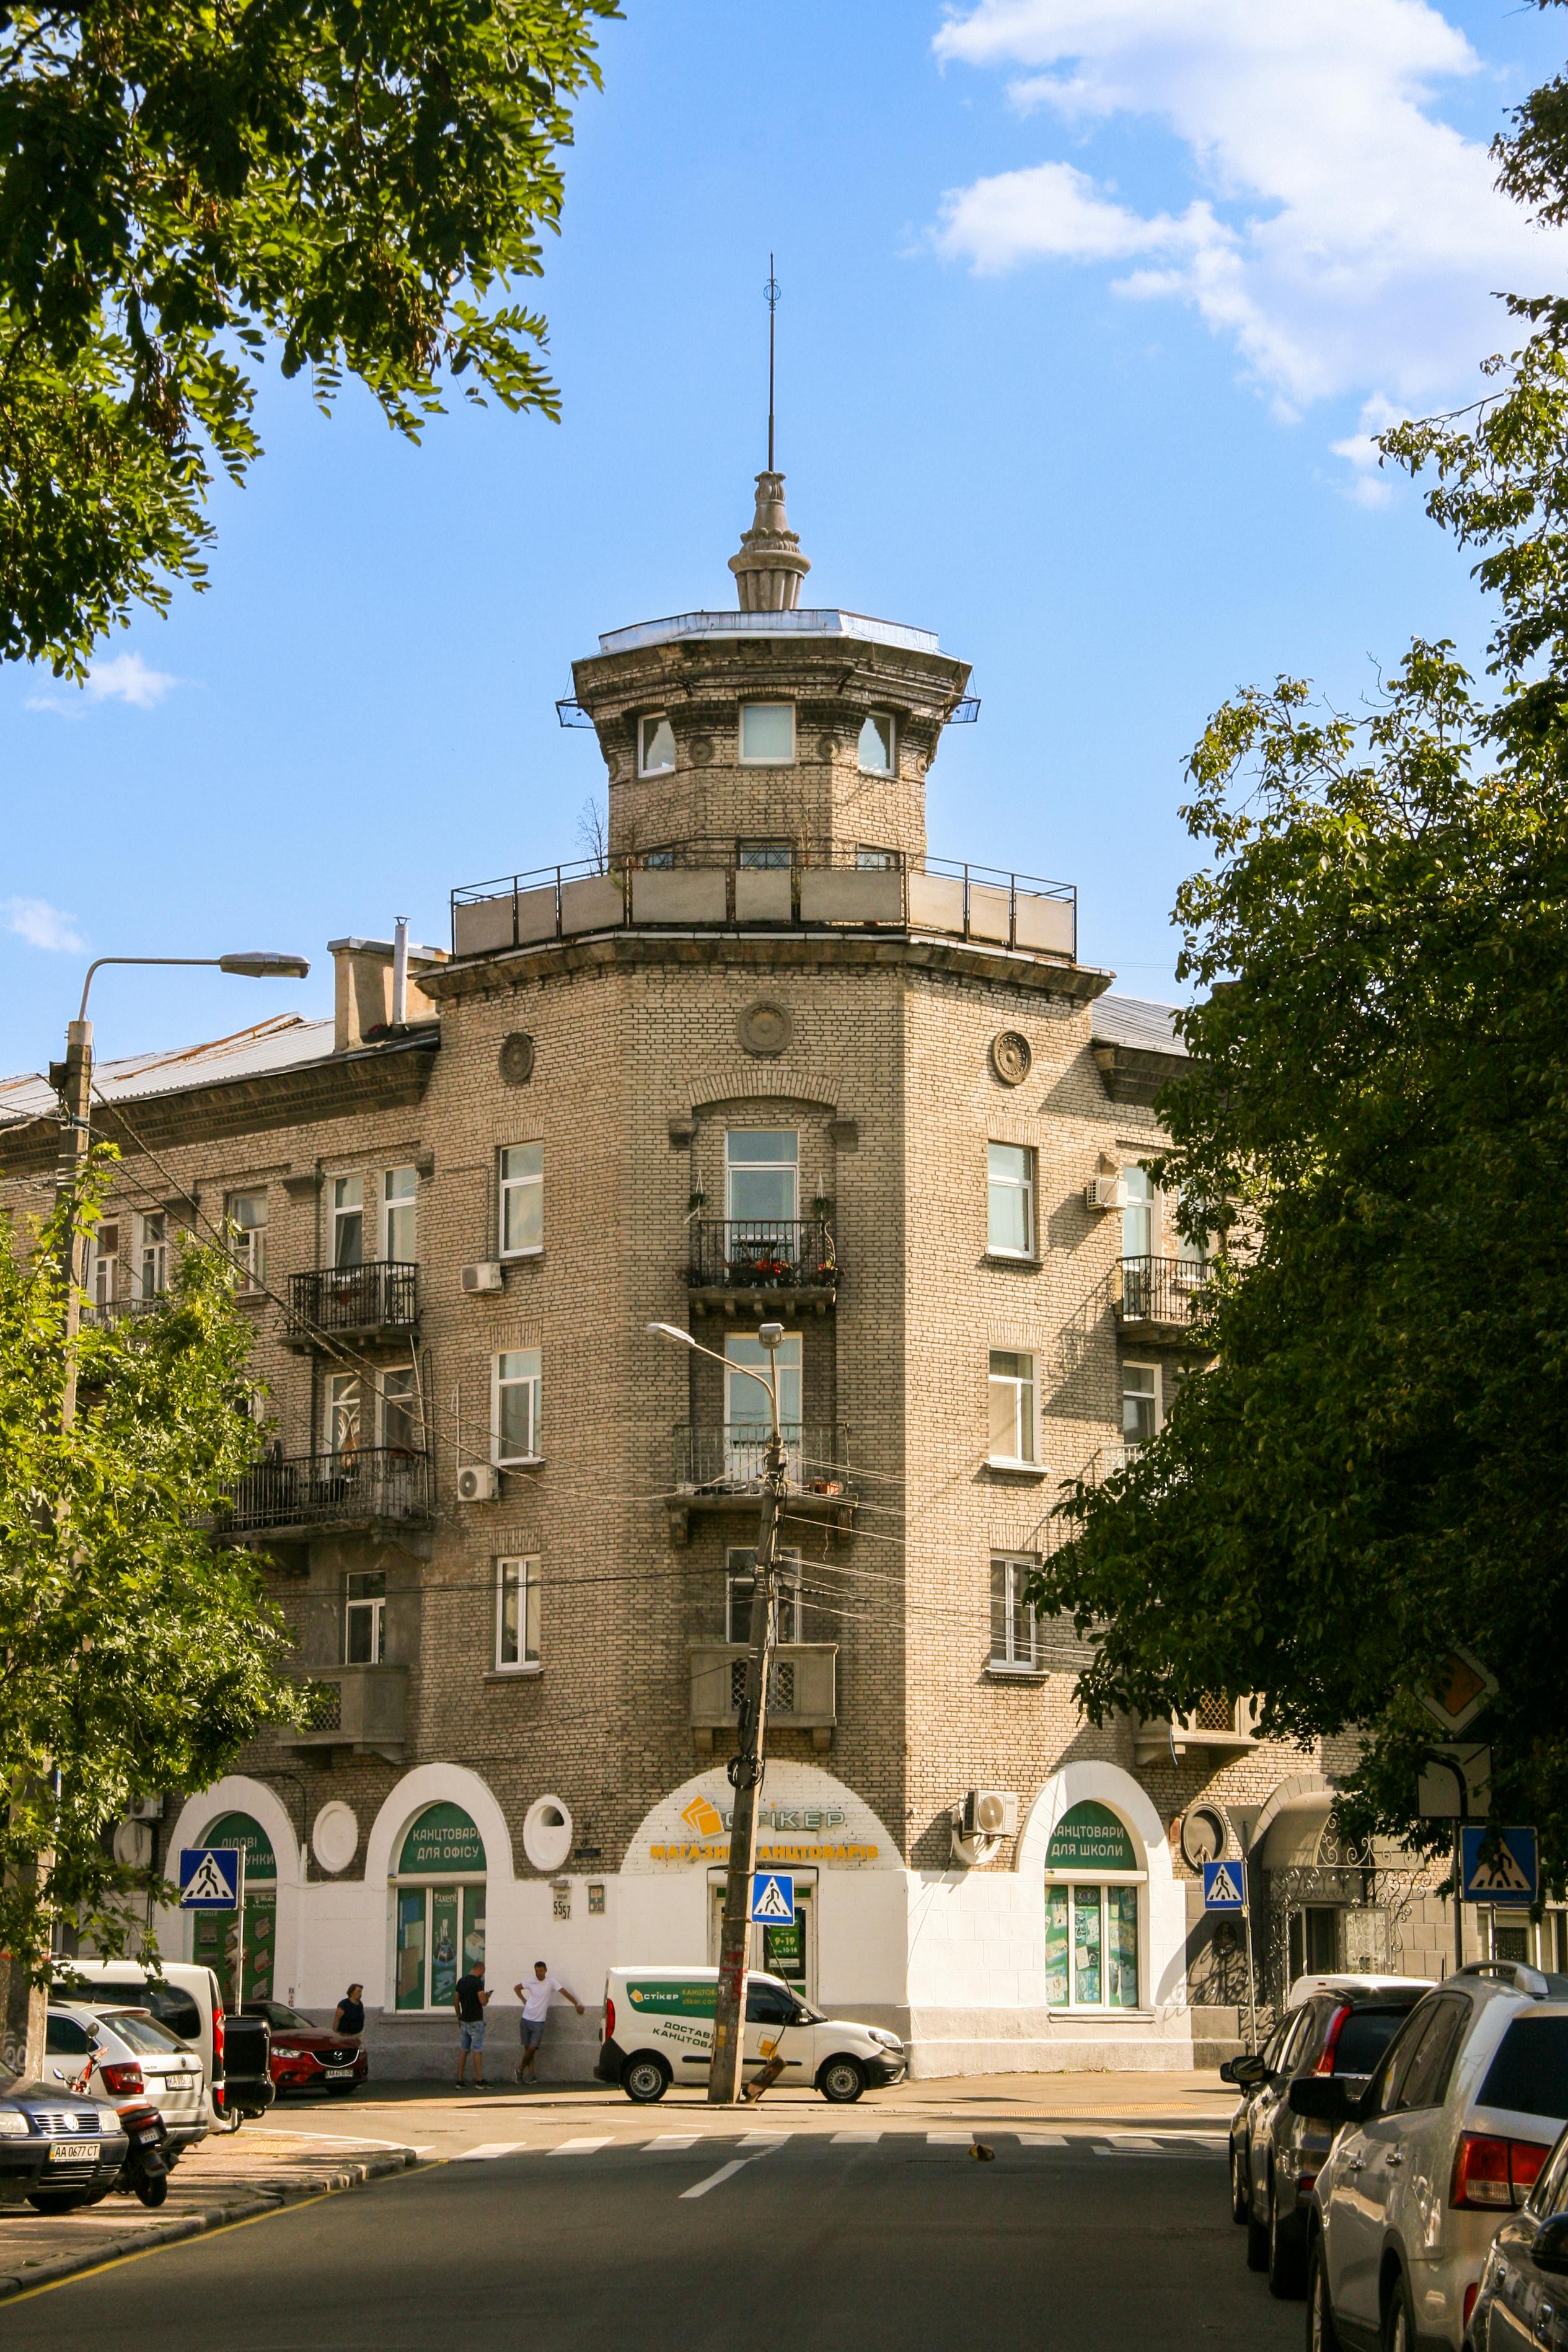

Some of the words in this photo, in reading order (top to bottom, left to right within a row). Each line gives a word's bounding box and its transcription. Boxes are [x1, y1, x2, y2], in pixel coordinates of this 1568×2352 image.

[416, 1847, 440, 1861] ДЛЯ
[444, 1846, 479, 1859] ОФІСУ
[757, 1844, 879, 1860] АНЦТОВАРІВ
[1051, 1844, 1076, 1857] ДЛЯ
[1080, 1844, 1123, 1856] ШКОЛИ
[682, 1988, 717, 1996] КАНЦТОВ
[55, 2146, 66, 2157] AA
[68, 2146, 86, 2157] 0677
[87, 2146, 99, 2156] CT
